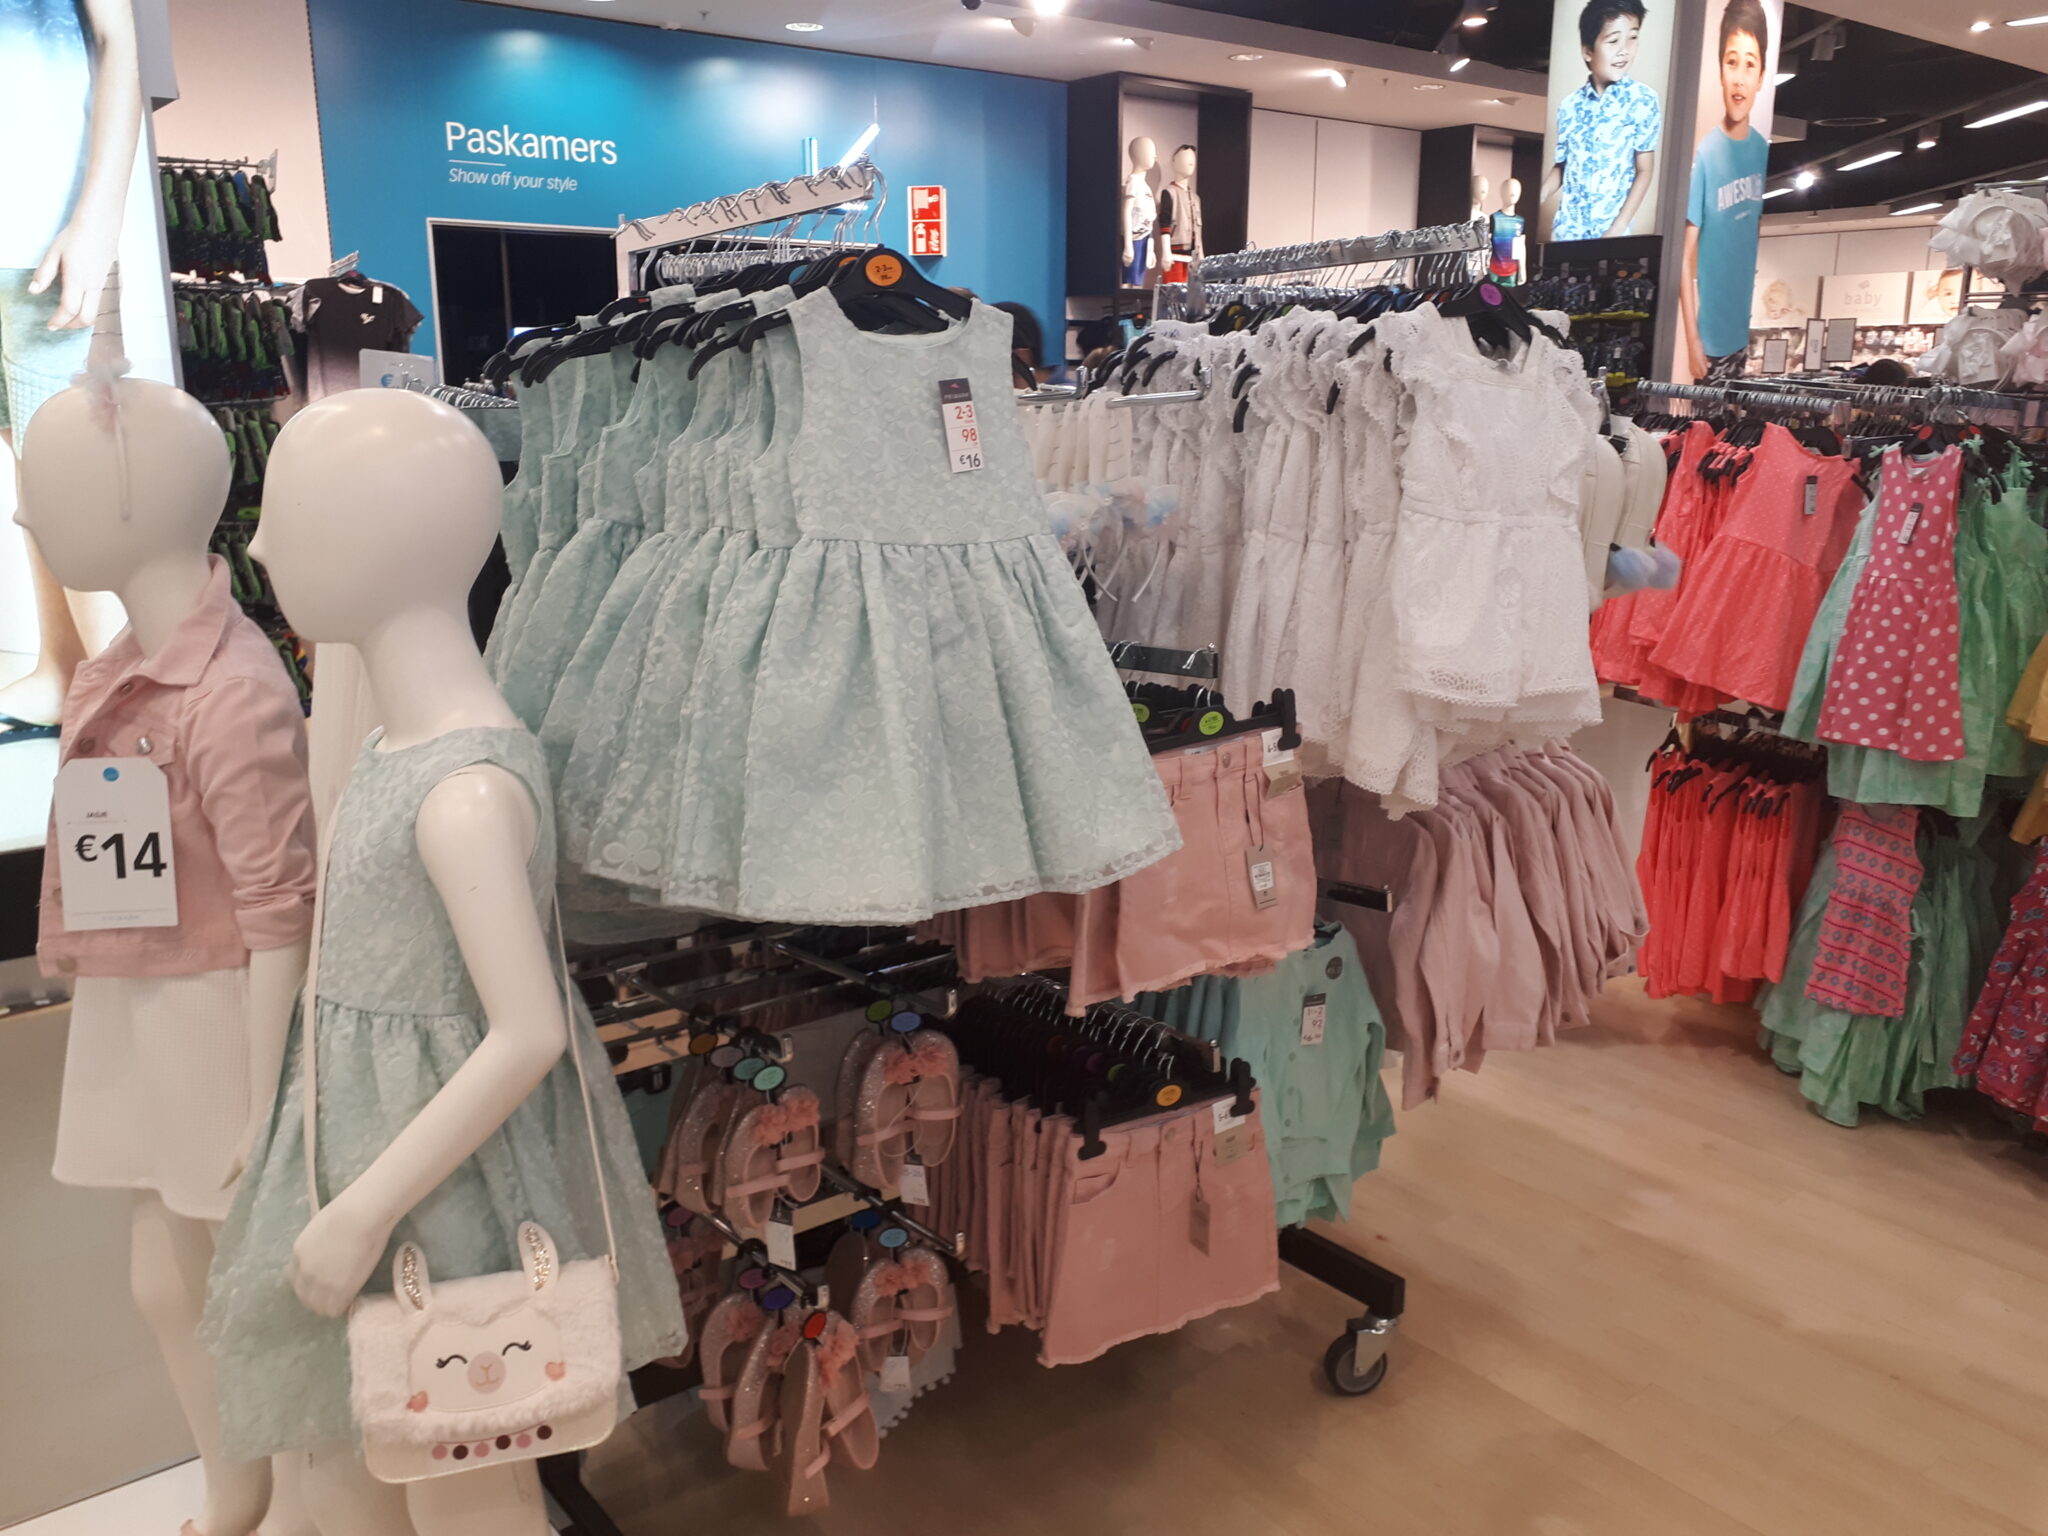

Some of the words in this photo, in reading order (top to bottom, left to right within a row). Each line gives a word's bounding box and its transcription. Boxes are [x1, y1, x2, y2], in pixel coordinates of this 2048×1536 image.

[446, 121, 618, 165] Paskamers
[448, 168, 489, 184] Show
[491, 171, 512, 186] off
[513, 174, 544, 190] your
[547, 177, 578, 193] style
[1844, 293, 1882, 307] baby
[955, 404, 974, 420] 2-3
[961, 428, 978, 443] 98
[959, 453, 981, 468] €16
[75, 831, 168, 880] €14
